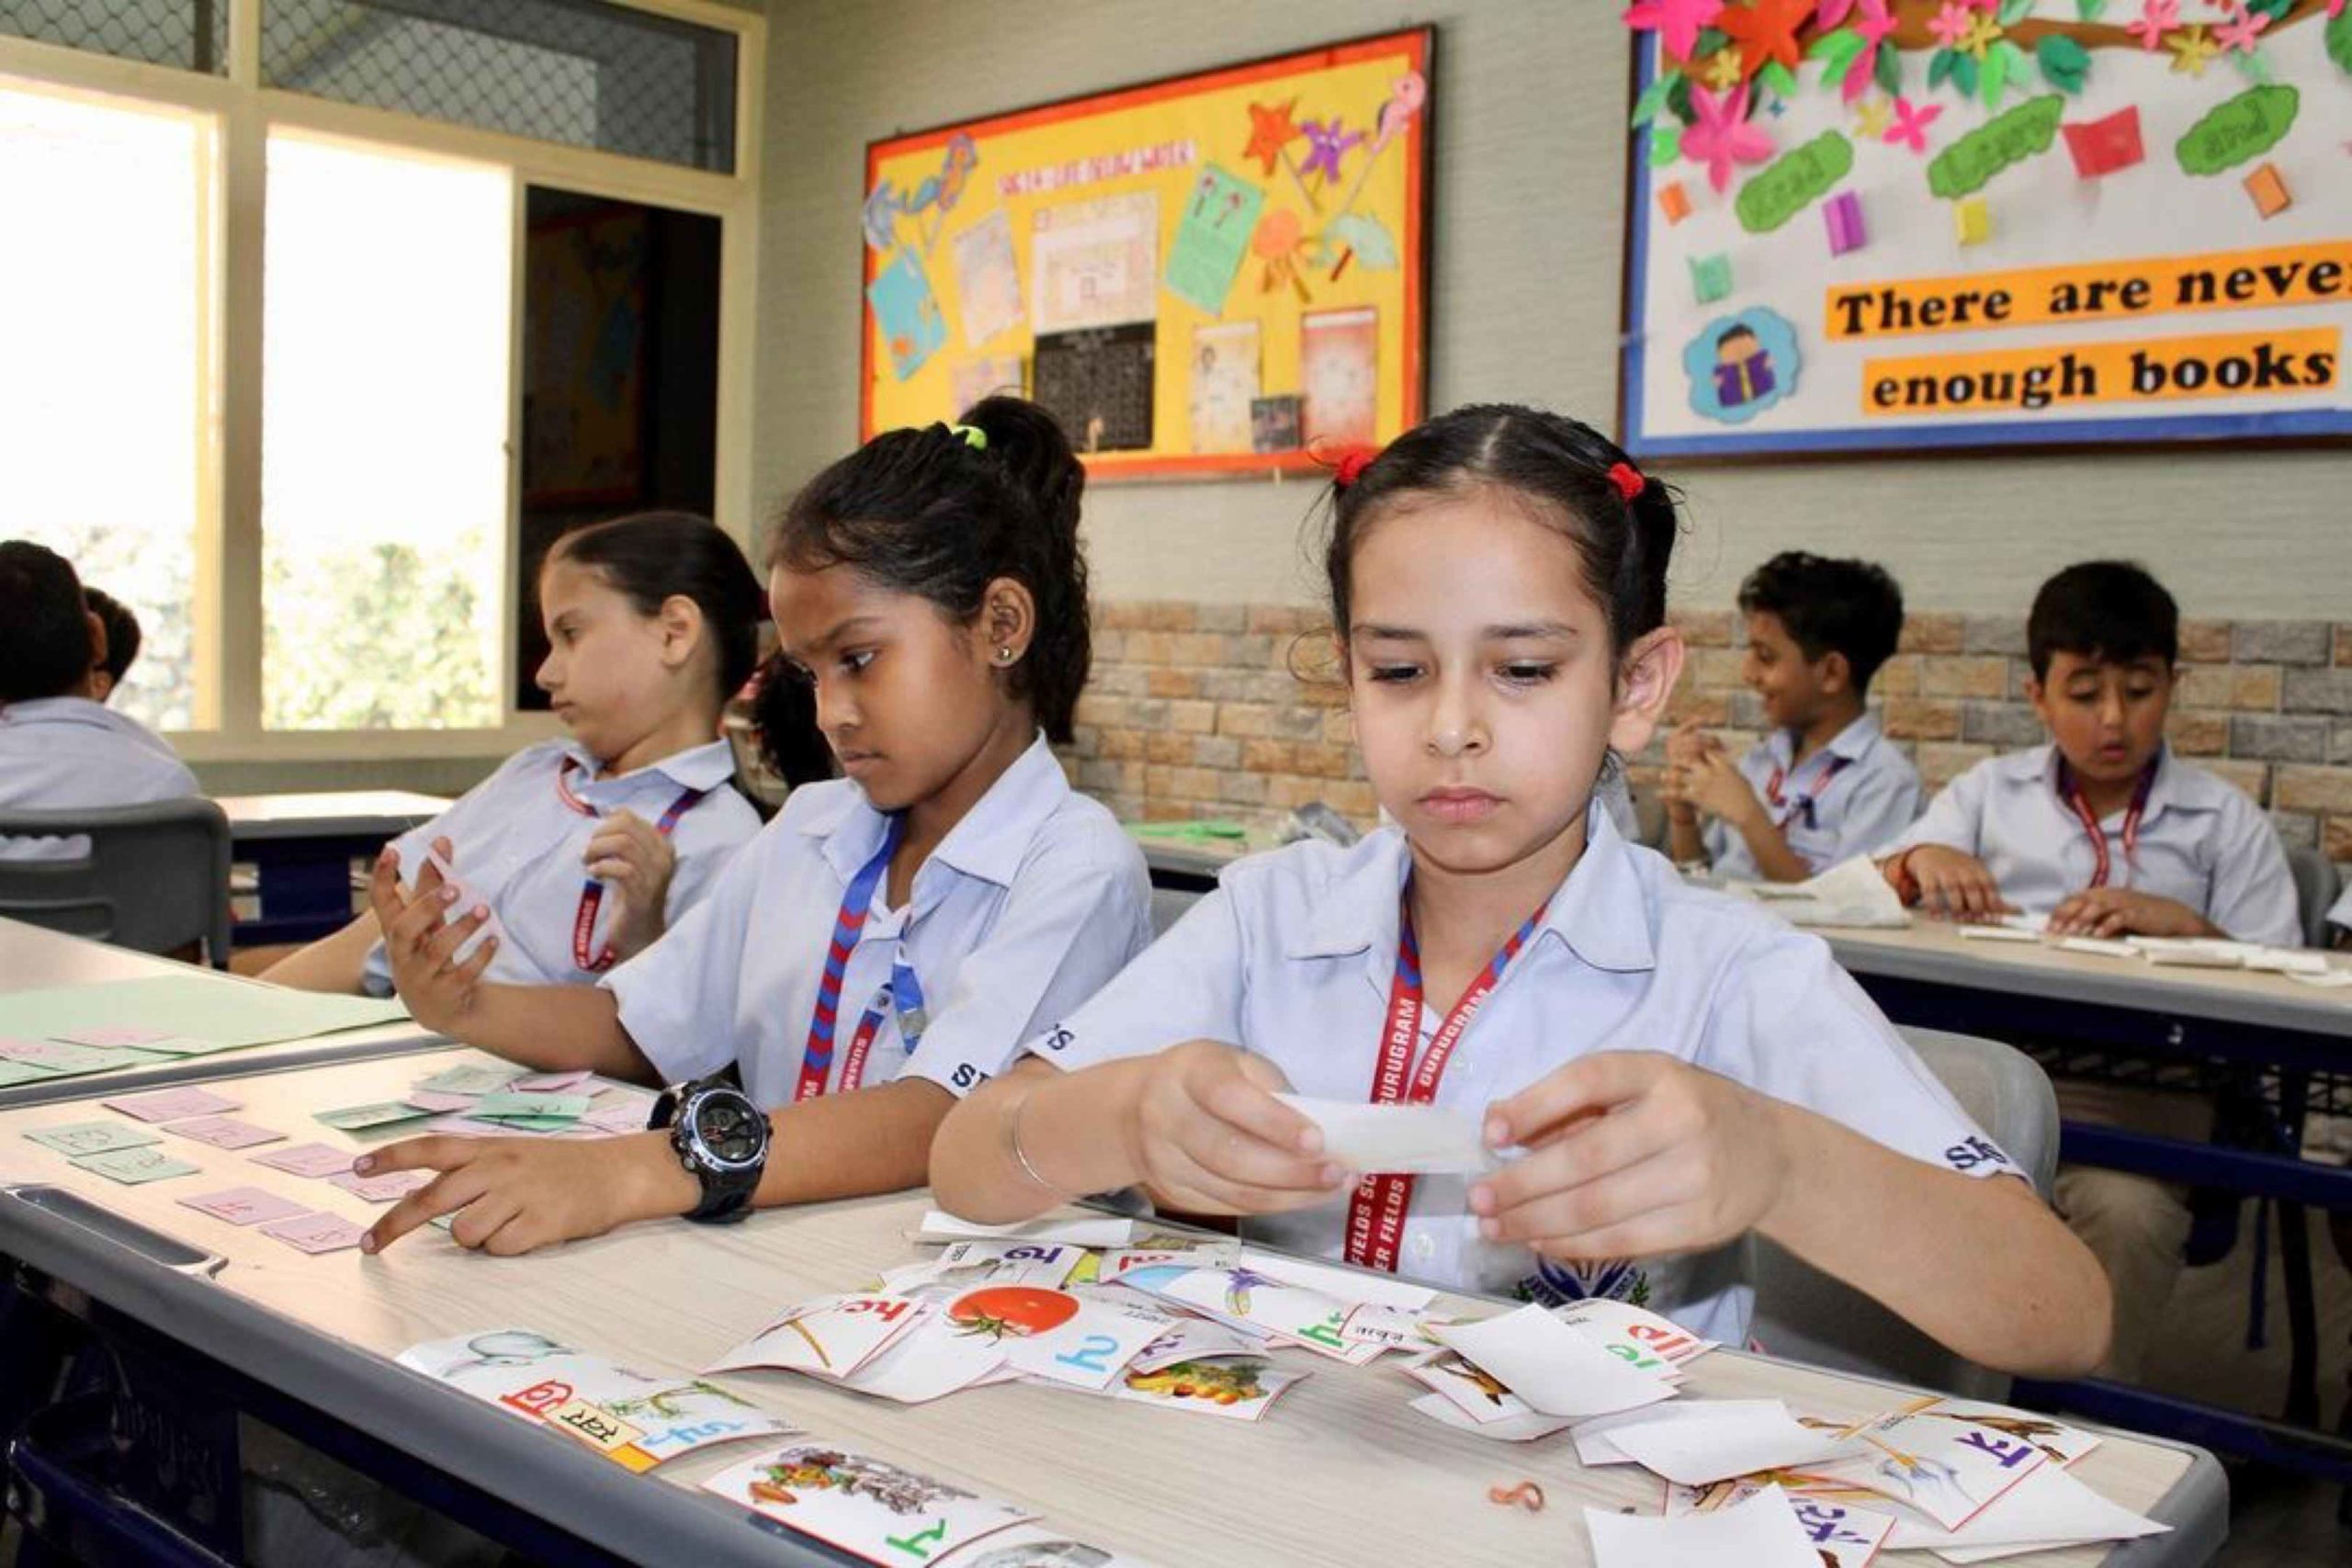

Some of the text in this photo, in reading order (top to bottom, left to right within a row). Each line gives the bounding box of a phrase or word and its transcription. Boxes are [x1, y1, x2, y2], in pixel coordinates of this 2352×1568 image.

[1836, 260, 2352, 334] There are neve
[1873, 344, 2335, 409] enough books
[1351, 1201, 1376, 1268] FIELDS
[1381, 1179, 1406, 1244] FIELDS
